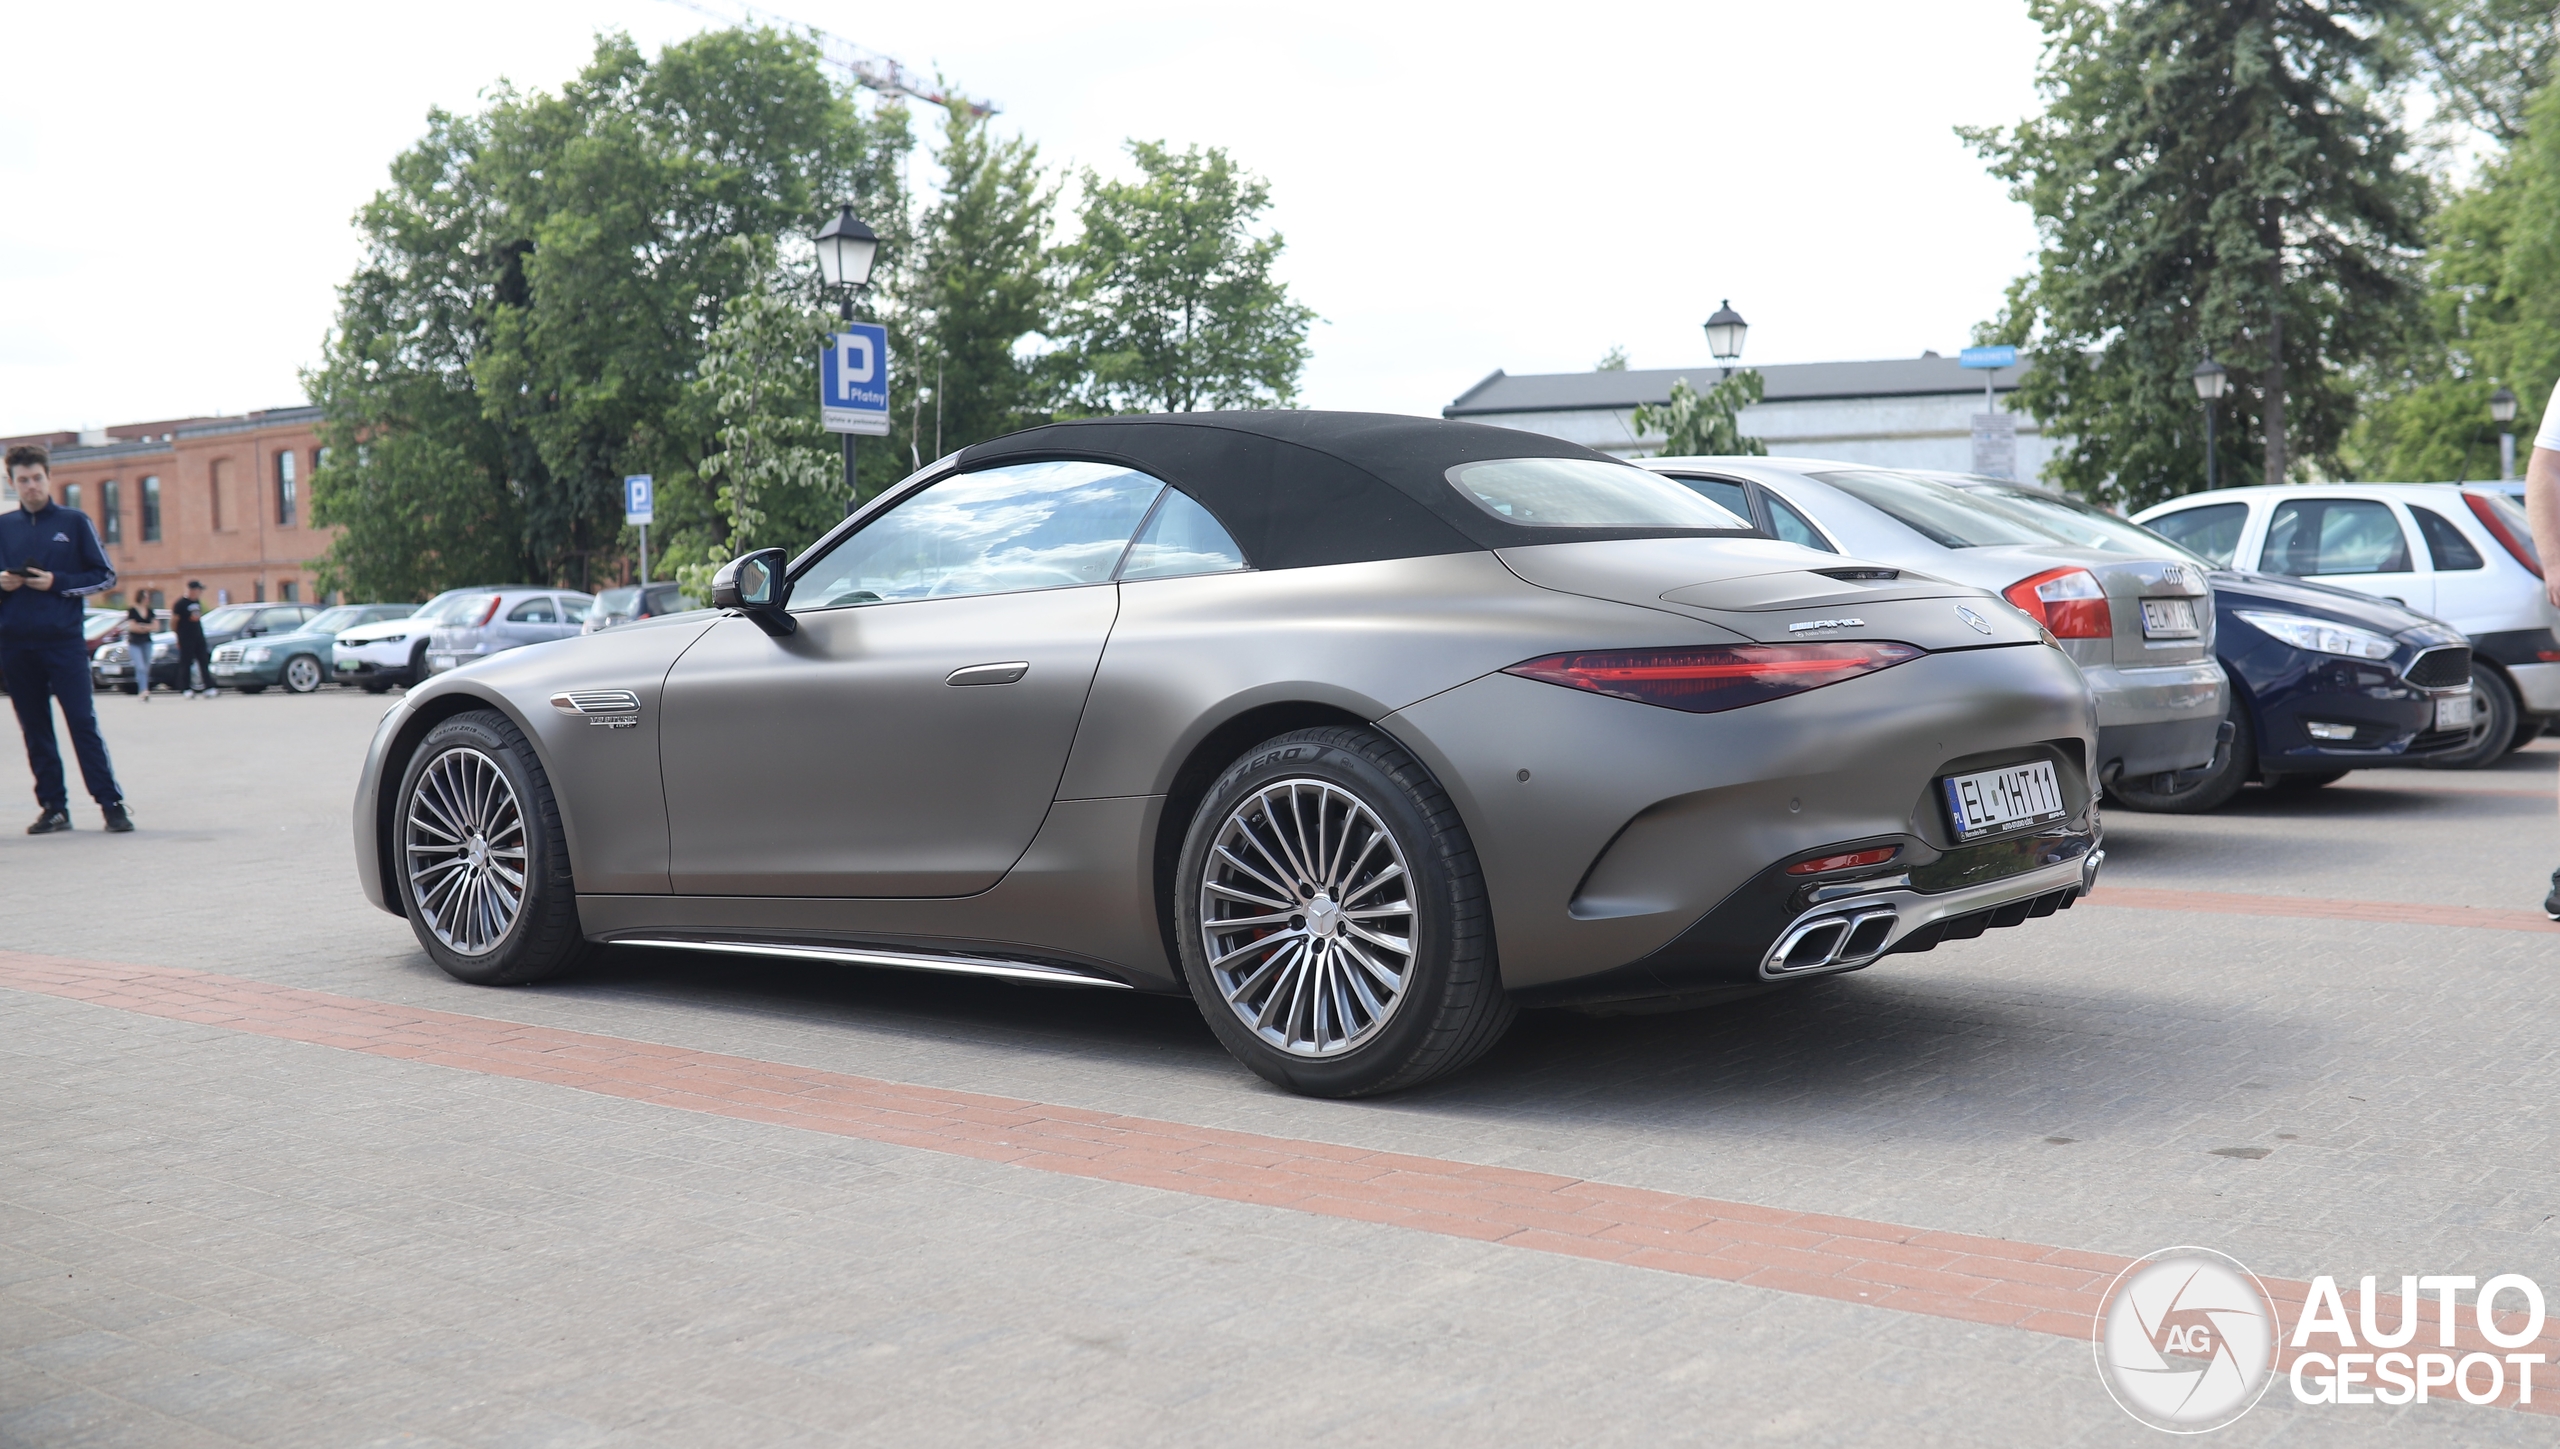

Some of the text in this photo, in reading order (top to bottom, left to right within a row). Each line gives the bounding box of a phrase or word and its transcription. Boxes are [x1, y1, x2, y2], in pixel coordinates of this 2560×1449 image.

[837, 333, 874, 400] P
[631, 481, 647, 511] P
[1814, 618, 1865, 629] AMG
[459, 725, 478, 734] ZR19
[1218, 748, 1301, 799] P ZERO
[1961, 767, 2056, 825] EL 1HT11
[1954, 812, 1963, 825] PL
